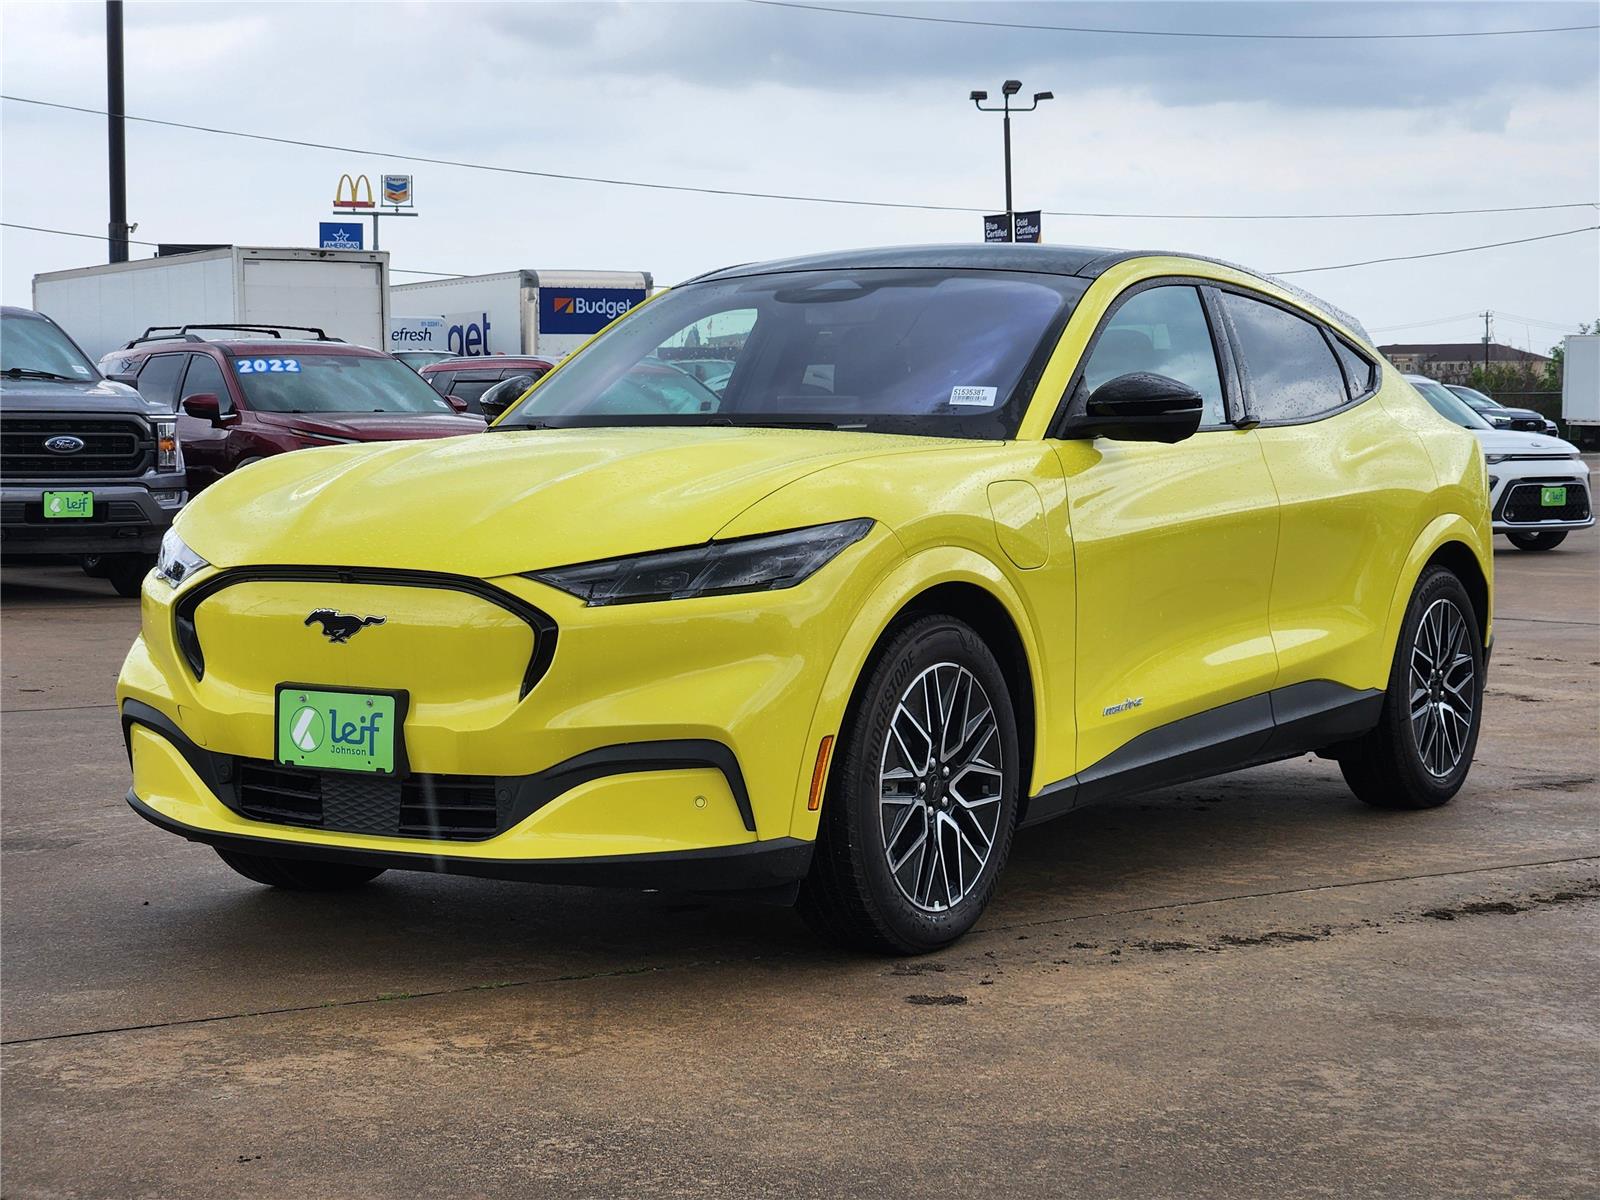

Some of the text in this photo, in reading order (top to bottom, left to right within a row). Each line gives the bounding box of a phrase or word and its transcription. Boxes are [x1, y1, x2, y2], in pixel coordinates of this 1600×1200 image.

[985, 222, 998, 230] Blue
[1016, 218, 1028, 226] Gold
[986, 229, 1008, 238] Certified
[1016, 225, 1039, 235] Certified
[575, 298, 632, 319] Budget
[237, 359, 300, 373] 2022
[54, 440, 76, 449] Ford
[330, 744, 367, 757] Johnson
